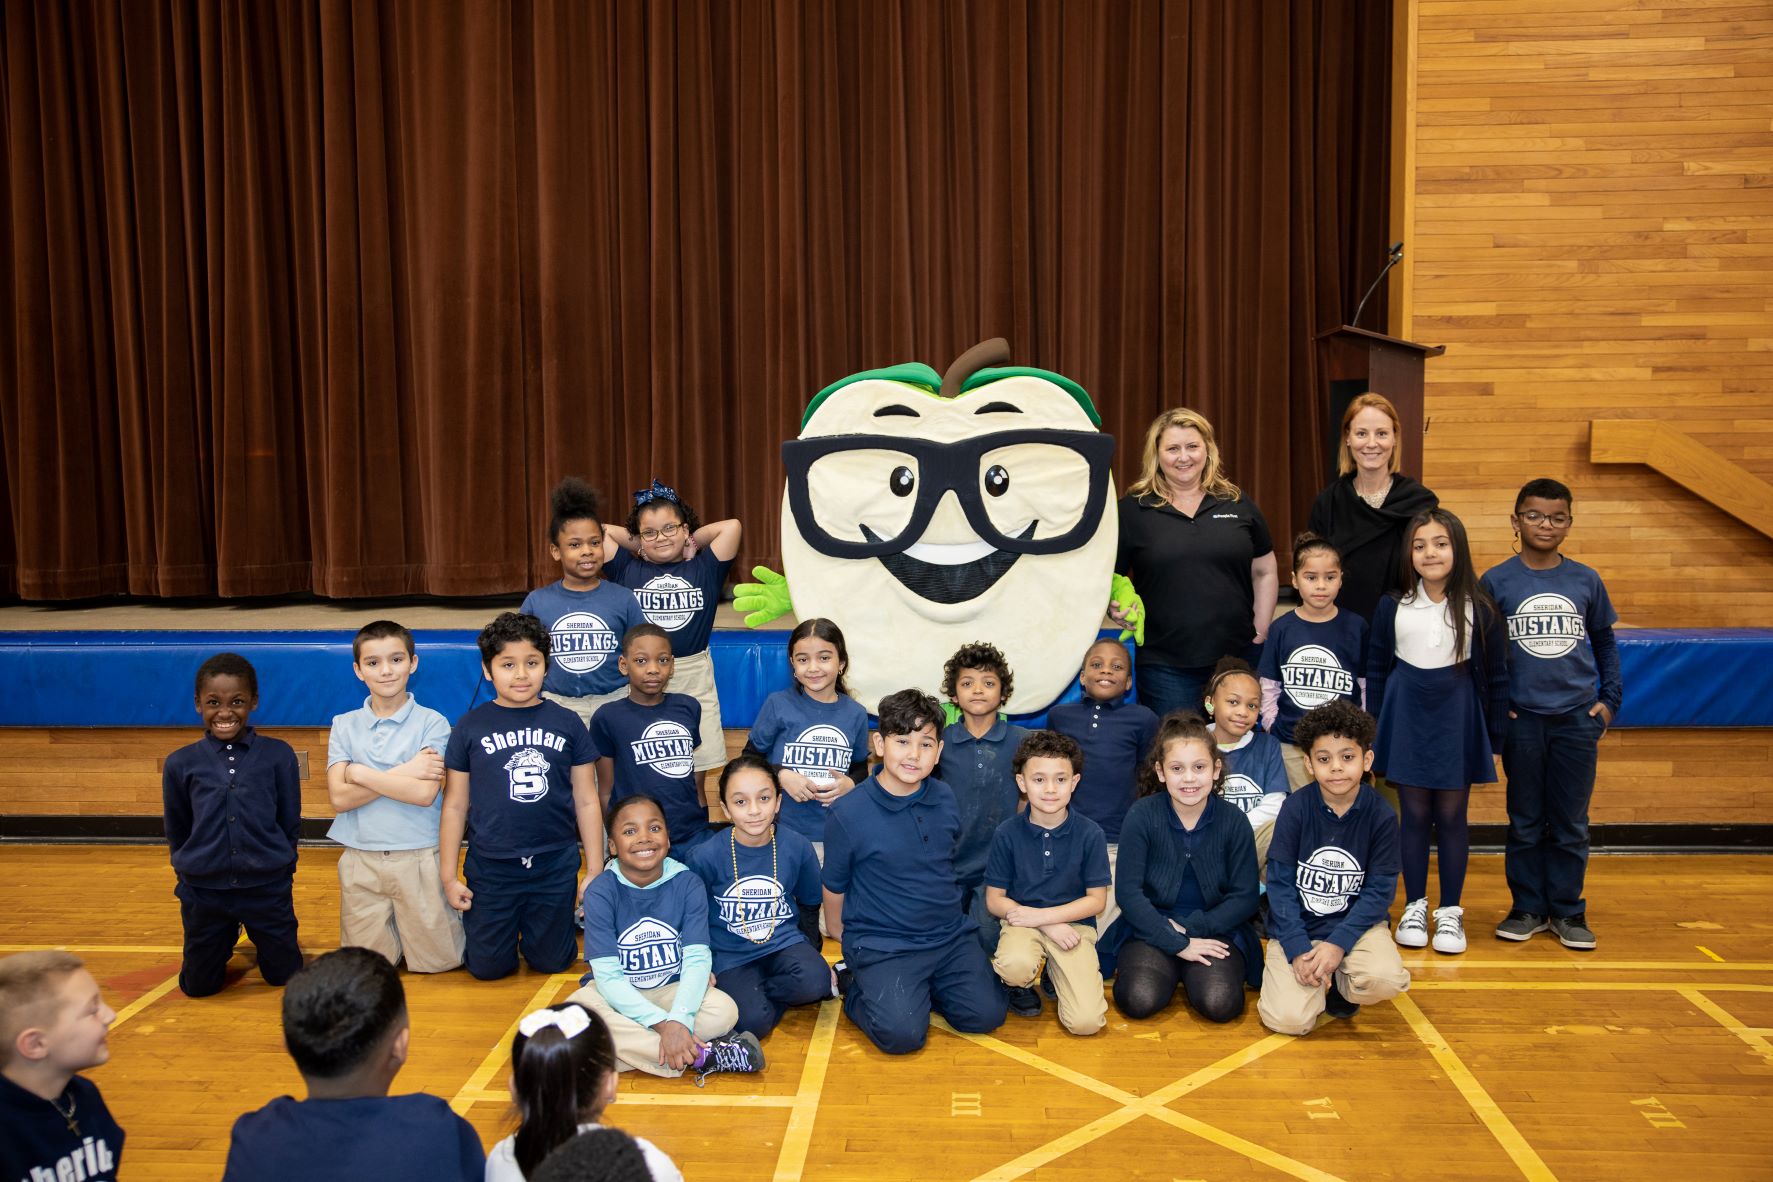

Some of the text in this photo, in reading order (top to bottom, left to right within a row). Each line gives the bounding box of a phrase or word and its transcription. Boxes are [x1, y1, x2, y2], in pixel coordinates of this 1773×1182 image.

[1507, 616, 1585, 637] MUSTANGS
[550, 633, 619, 652] USTANGS
[1301, 655, 1327, 665] SHERIDAN
[481, 727, 567, 755] Sheridan
[812, 735, 838, 743] SHERIDAN
[741, 888, 772, 896] SHERIDAN
